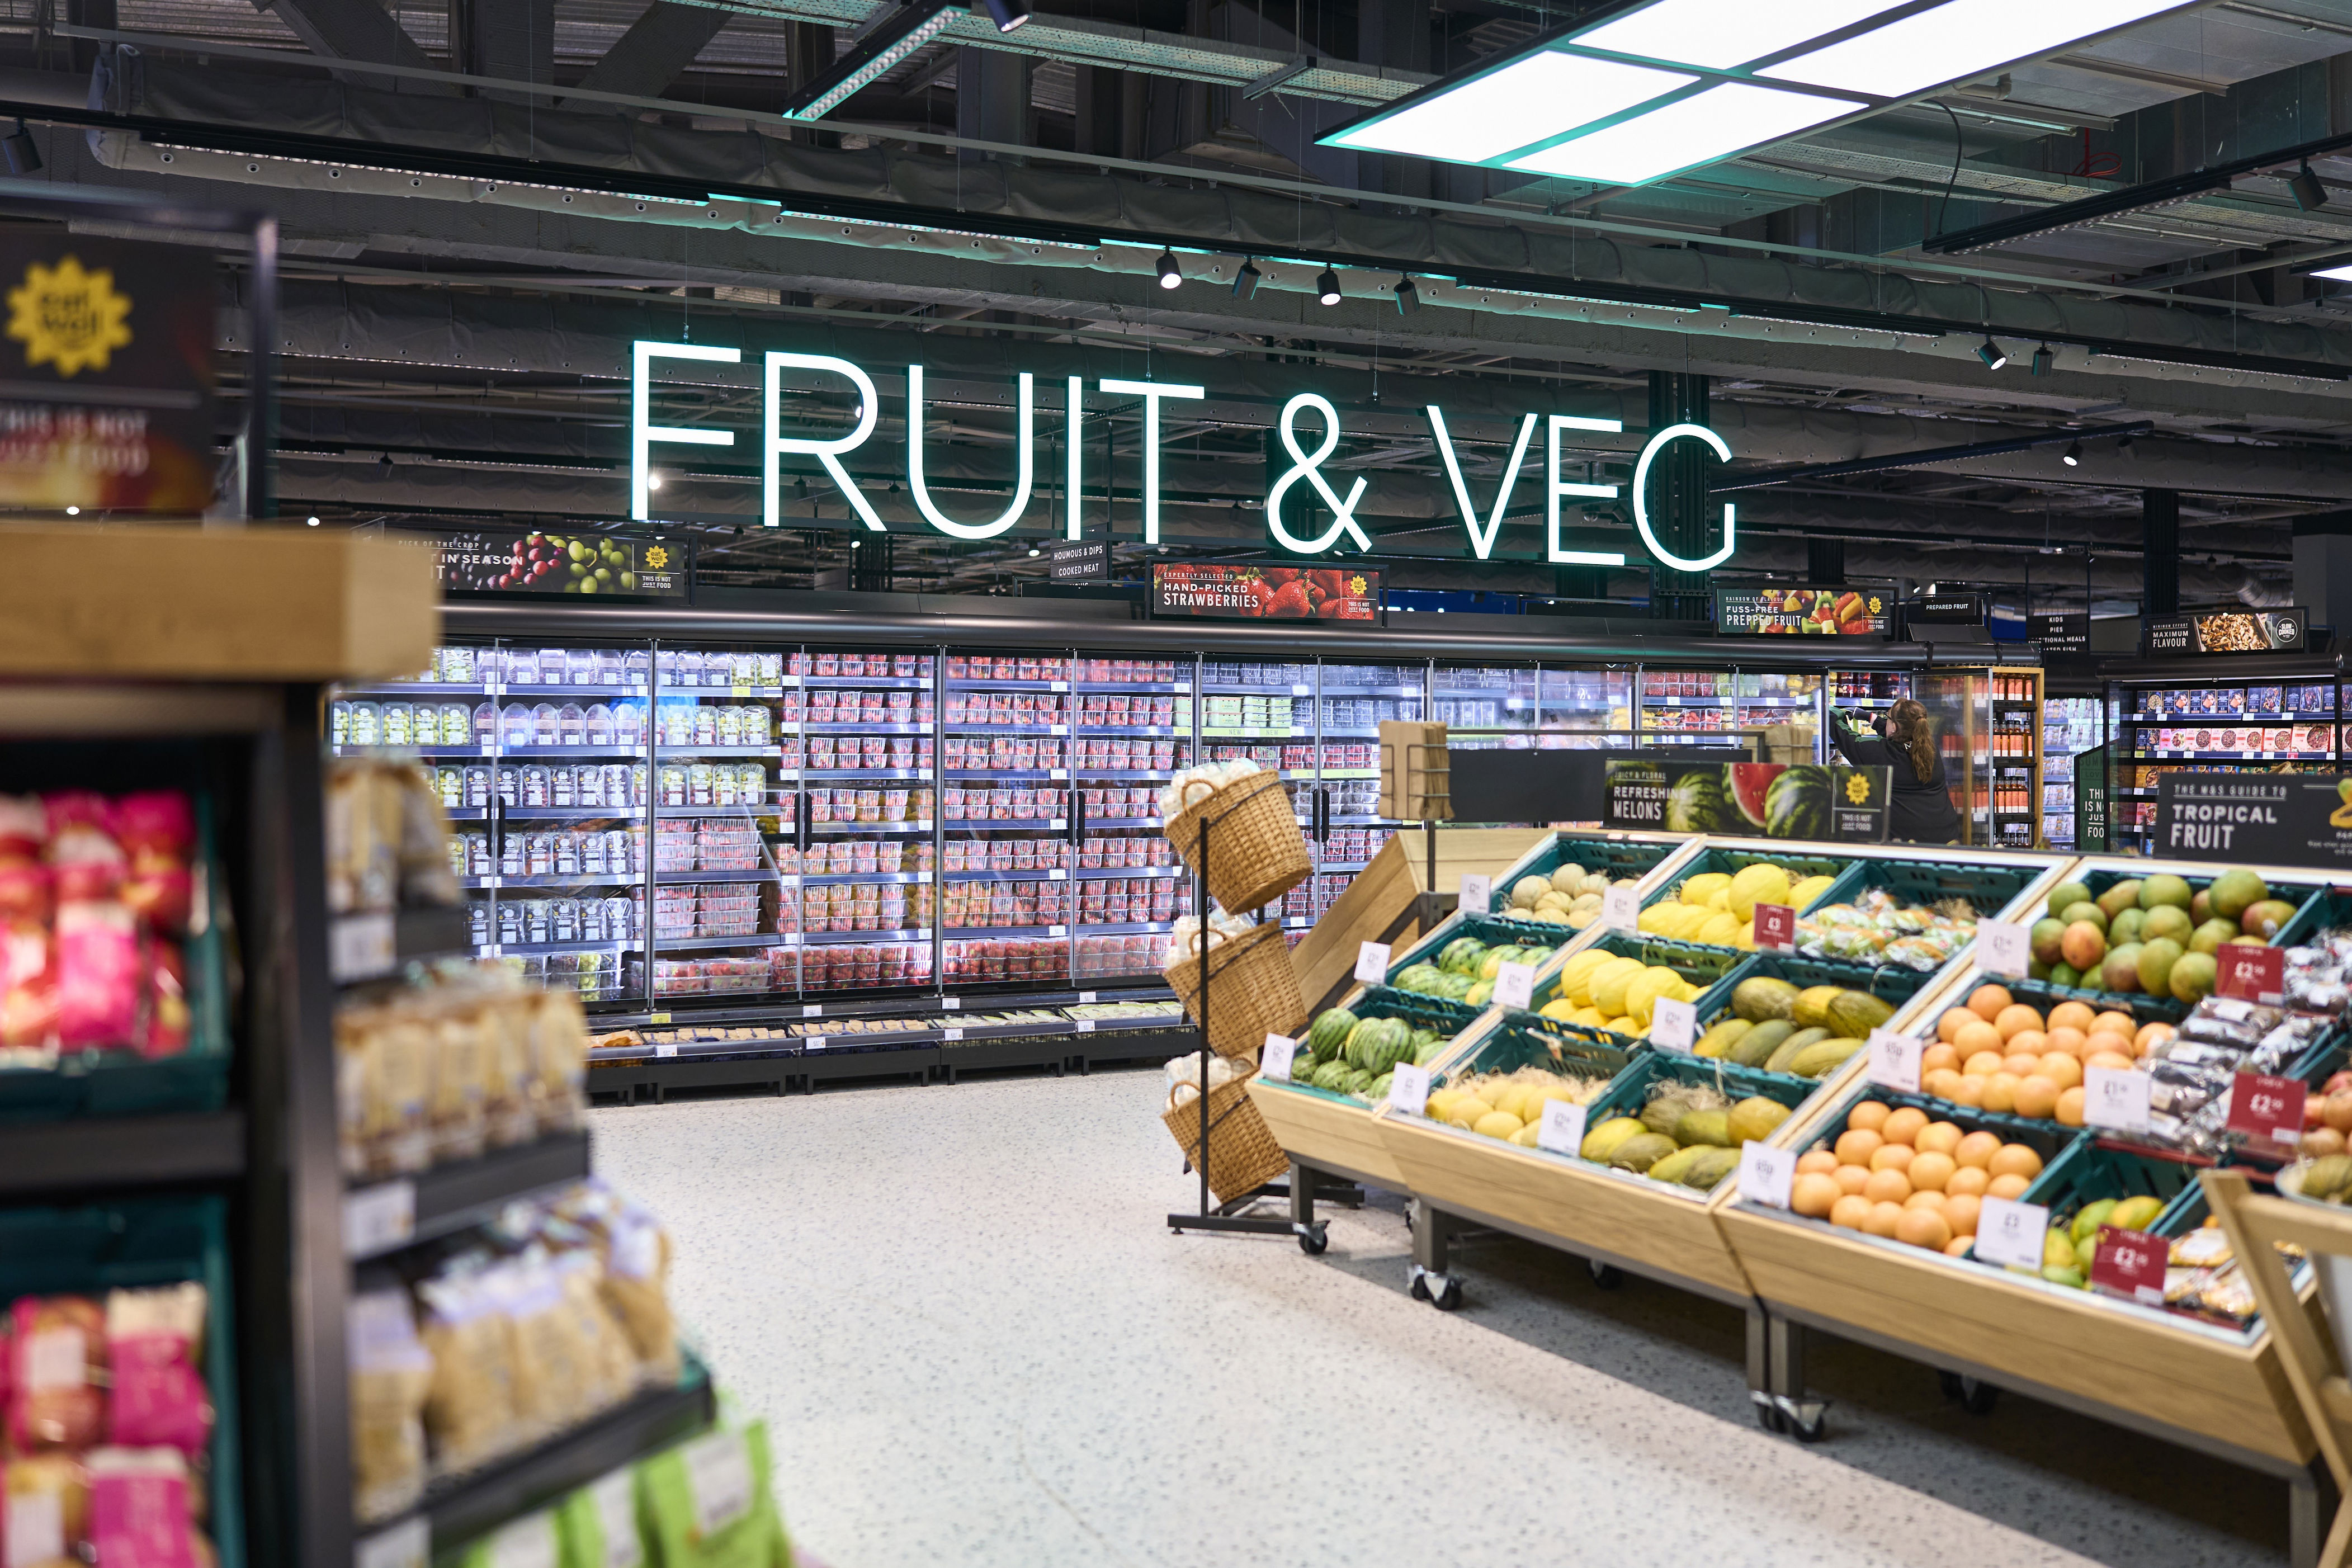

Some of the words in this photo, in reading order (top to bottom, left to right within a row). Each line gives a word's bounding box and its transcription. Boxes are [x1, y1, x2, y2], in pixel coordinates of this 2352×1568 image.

[631, 339, 1205, 546] FRUIT
[1266, 392, 1373, 554] &
[1425, 405, 1735, 572] VEG
[1054, 548, 1082, 560] HOUMOUS
[1084, 547, 1088, 556] &
[1089, 545, 1103, 555] DIPS
[442, 554, 457, 563] IN
[462, 554, 523, 565] SEASON
[1059, 565, 1082, 577] COOKED
[1083, 563, 1099, 573] MEAT
[1164, 583, 1248, 593] HAND-PICKED
[1164, 593, 1258, 608] STRAWBERRIES
[1726, 614, 1771, 626] PREPPED
[1774, 615, 1801, 626] FRUIT
[2153, 637, 2186, 648] FLAVOUR
[1614, 786, 1687, 800] REFRESHING
[2089, 788, 2104, 799] THI
[2174, 784, 2195, 794] THE
[2200, 785, 2224, 796] M&S
[2229, 785, 2266, 797] GUIDE
[2272, 786, 2287, 797] TO
[1613, 800, 1662, 820] MELONS
[2085, 801, 2094, 812] IS
[2096, 801, 2113, 813] NT
[2172, 804, 2277, 824] TROPICAL
[1855, 823, 1872, 832] FOOD
[2087, 826, 2104, 838] FOO
[2170, 823, 2235, 850] FRUIT
